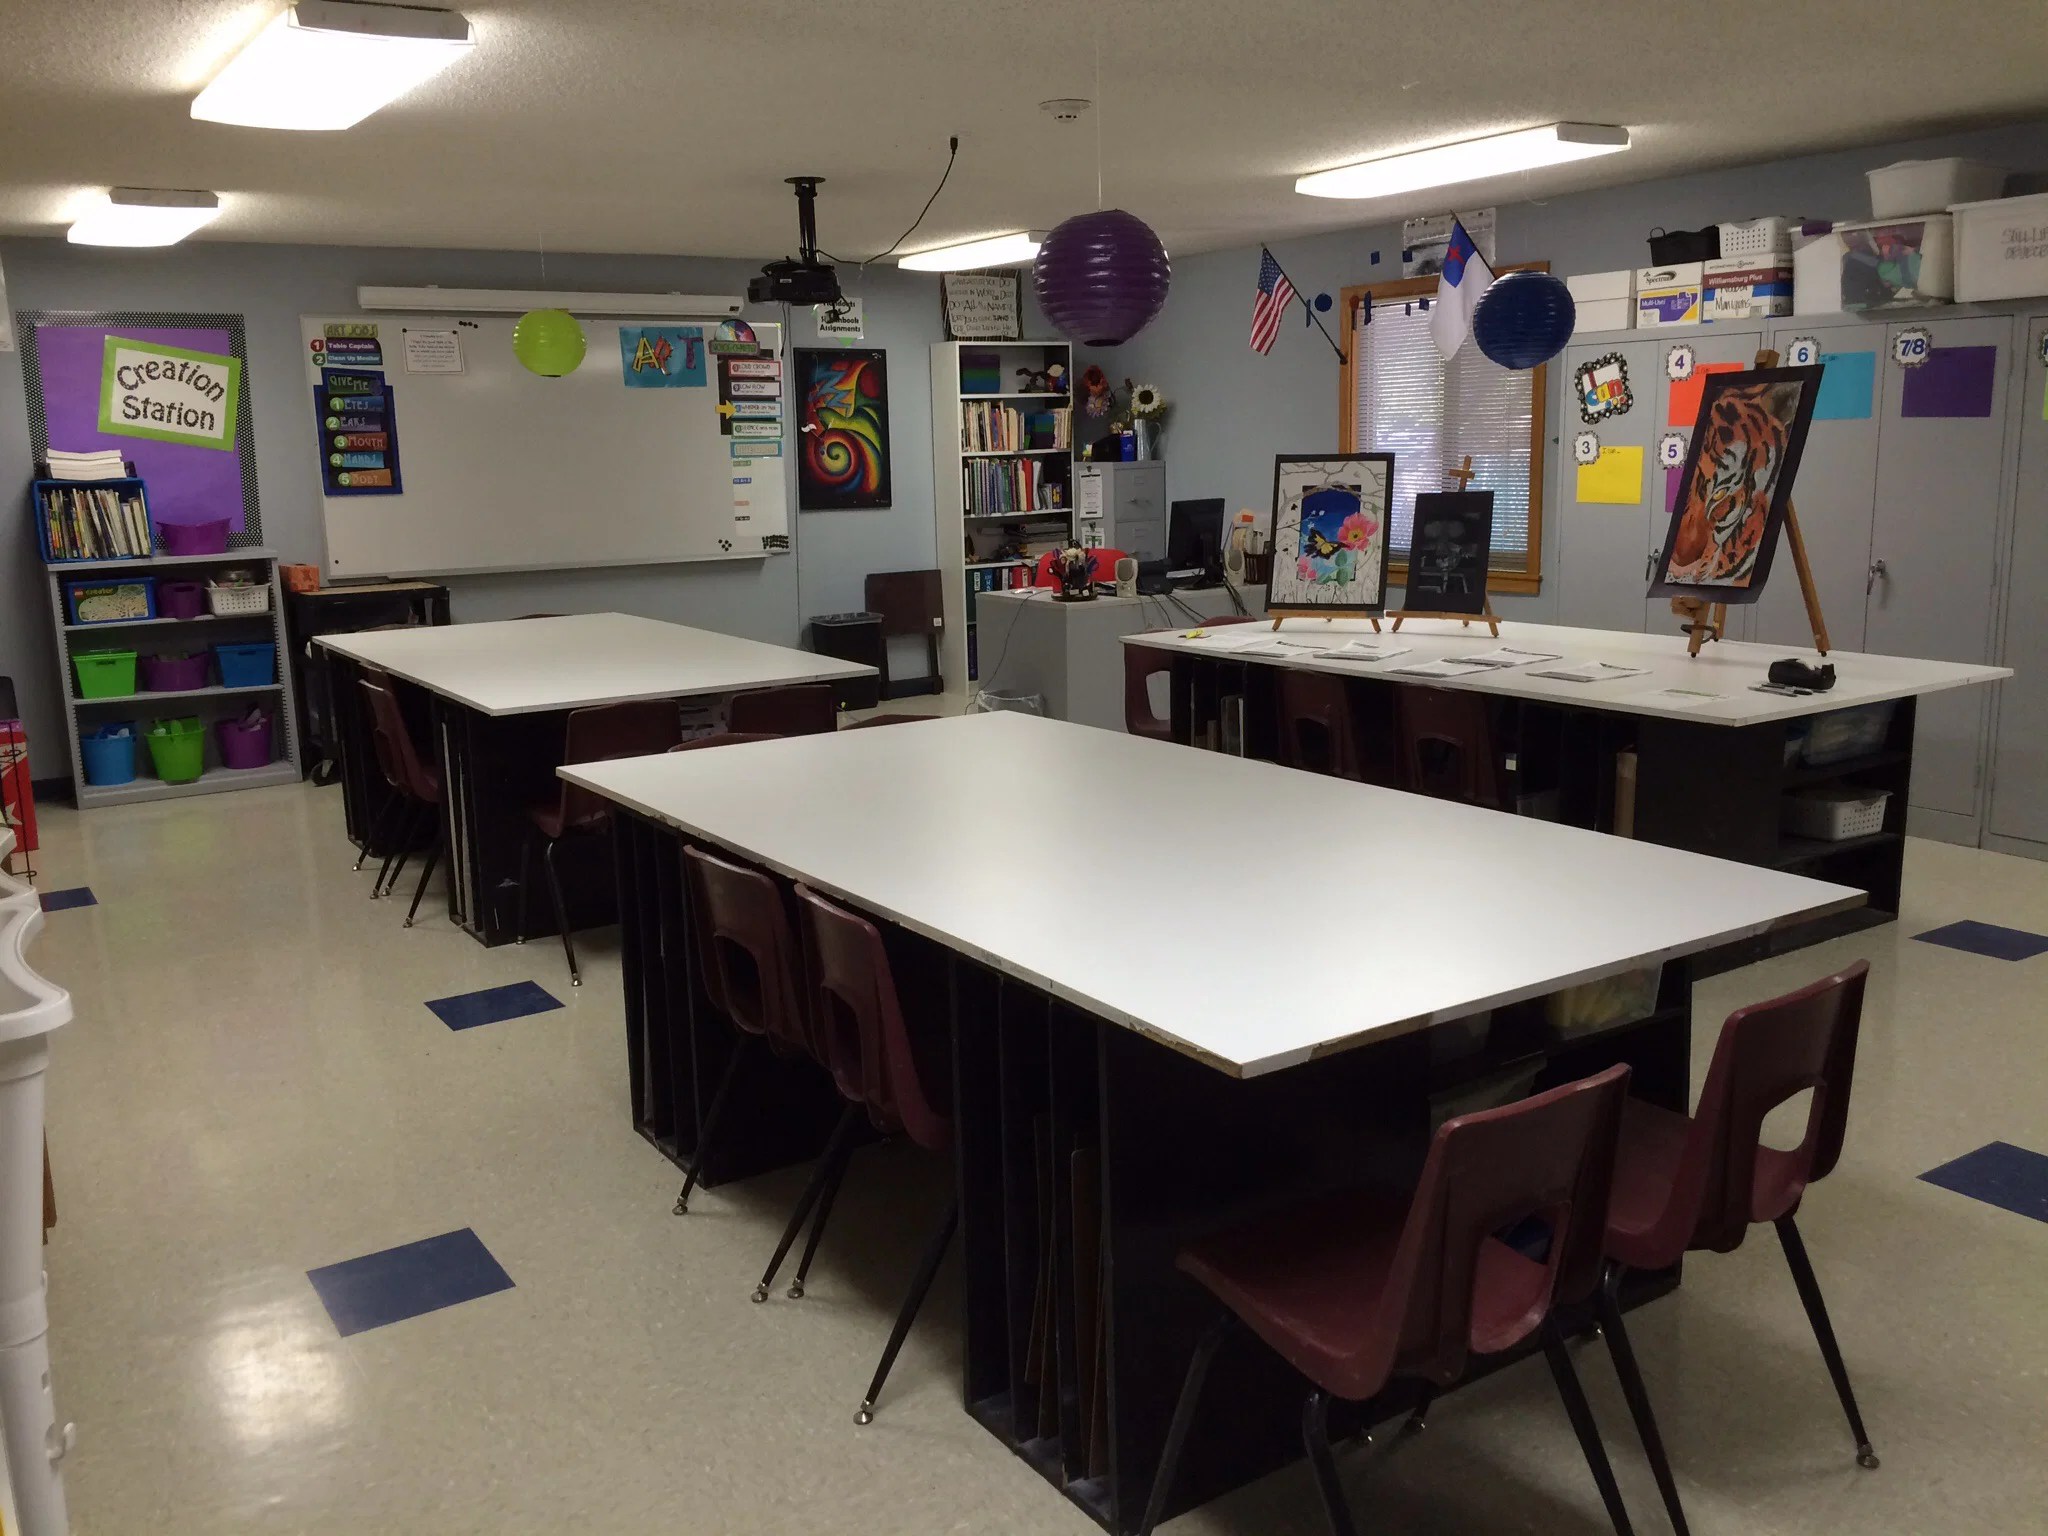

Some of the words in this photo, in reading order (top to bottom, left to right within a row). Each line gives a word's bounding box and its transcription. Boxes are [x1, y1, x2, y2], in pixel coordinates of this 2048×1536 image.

[1708, 275, 1748, 286] Williamsburg
[1748, 273, 1763, 283] Plus
[819, 323, 861, 334] Assignments
[313, 340, 321, 351] 1
[348, 343, 375, 351] Captain
[631, 329, 704, 376] ART
[1899, 337, 1926, 357] 7/8
[315, 355, 324, 365] 2
[1674, 354, 1685, 370] 4
[1797, 347, 1809, 363] 6
[116, 359, 225, 403] Creation
[329, 375, 353, 387] GIVE
[352, 379, 370, 391] ME
[333, 400, 340, 410] 1
[344, 399, 369, 411] EYES
[121, 395, 215, 431] Station
[328, 418, 338, 429] 2
[340, 416, 366, 428] EARS
[337, 437, 346, 448] 3
[348, 435, 384, 448] MOUTH
[1581, 440, 1591, 455] 3
[1667, 443, 1678, 459] 5
[331, 454, 342, 466] 4
[343, 452, 376, 464] HANDS
[341, 474, 351, 485] 5
[351, 473, 379, 485] BODY
